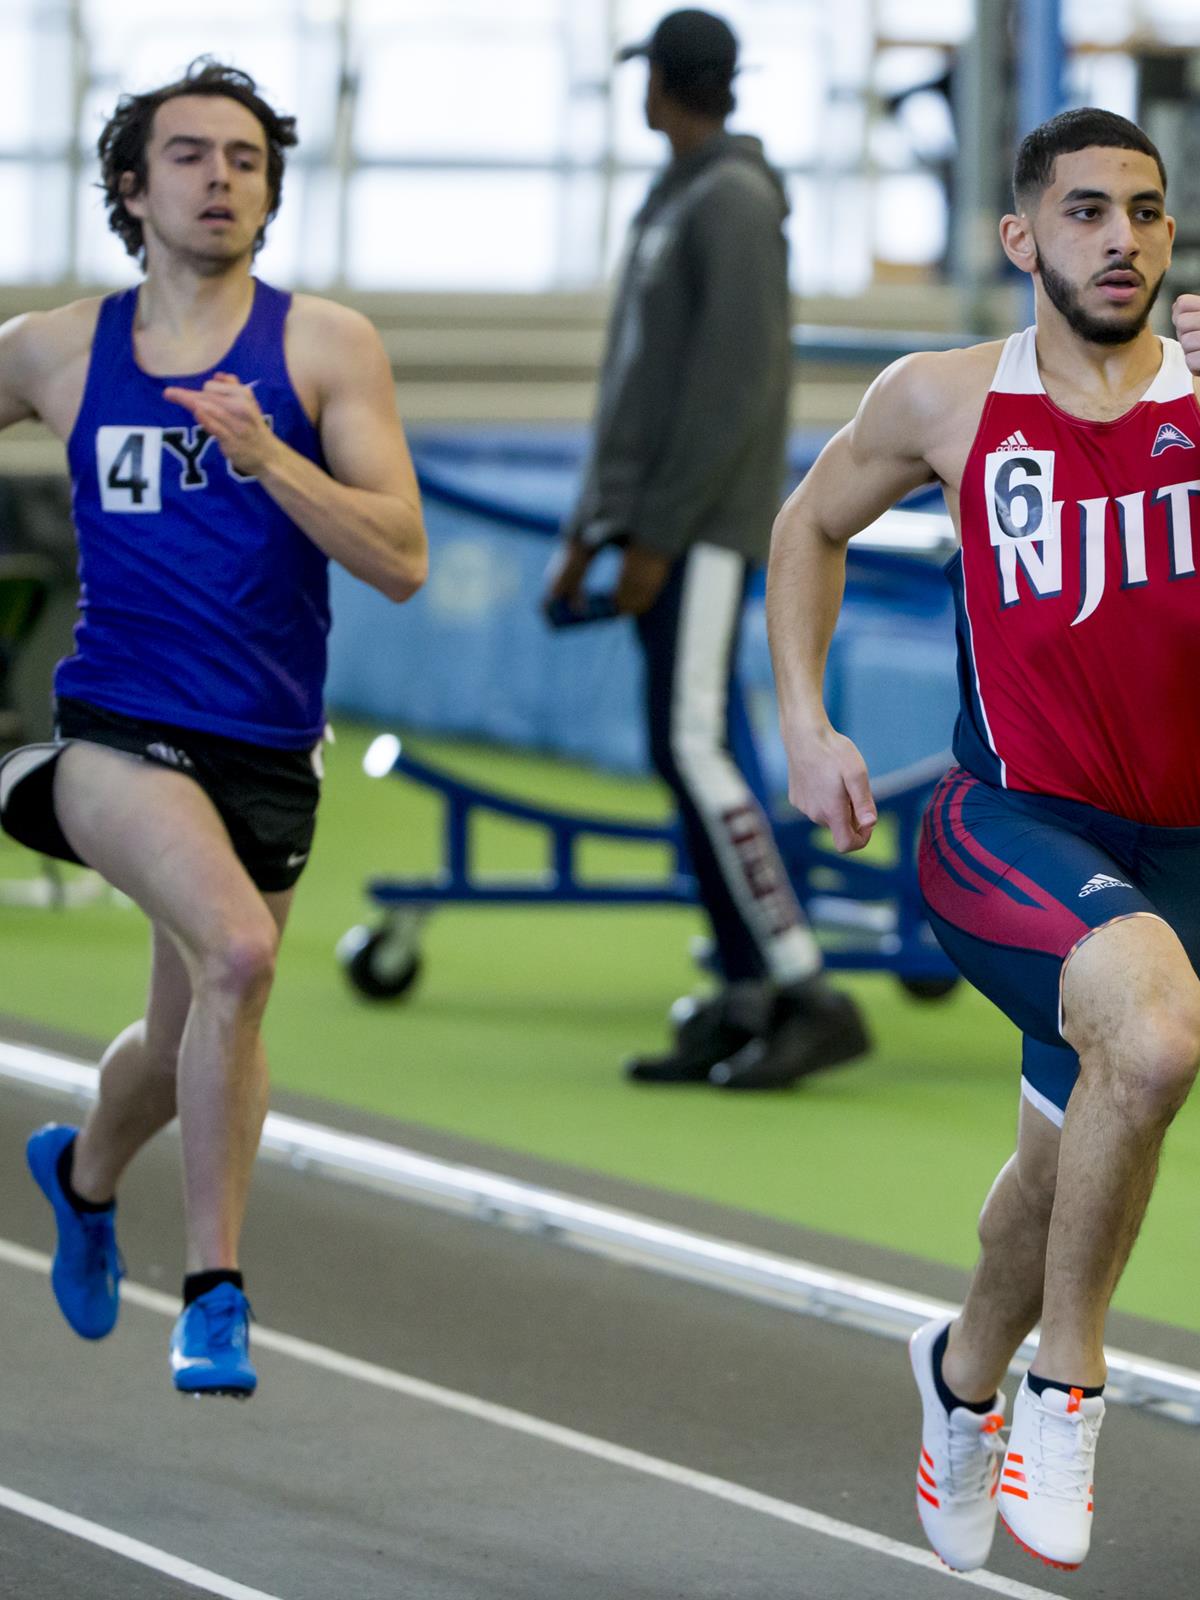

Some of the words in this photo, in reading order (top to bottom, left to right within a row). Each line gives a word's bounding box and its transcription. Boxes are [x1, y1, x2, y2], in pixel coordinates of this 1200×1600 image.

[107, 433, 148, 504] 4
[994, 457, 1044, 538] 6
[1078, 881, 1133, 898] adidas
